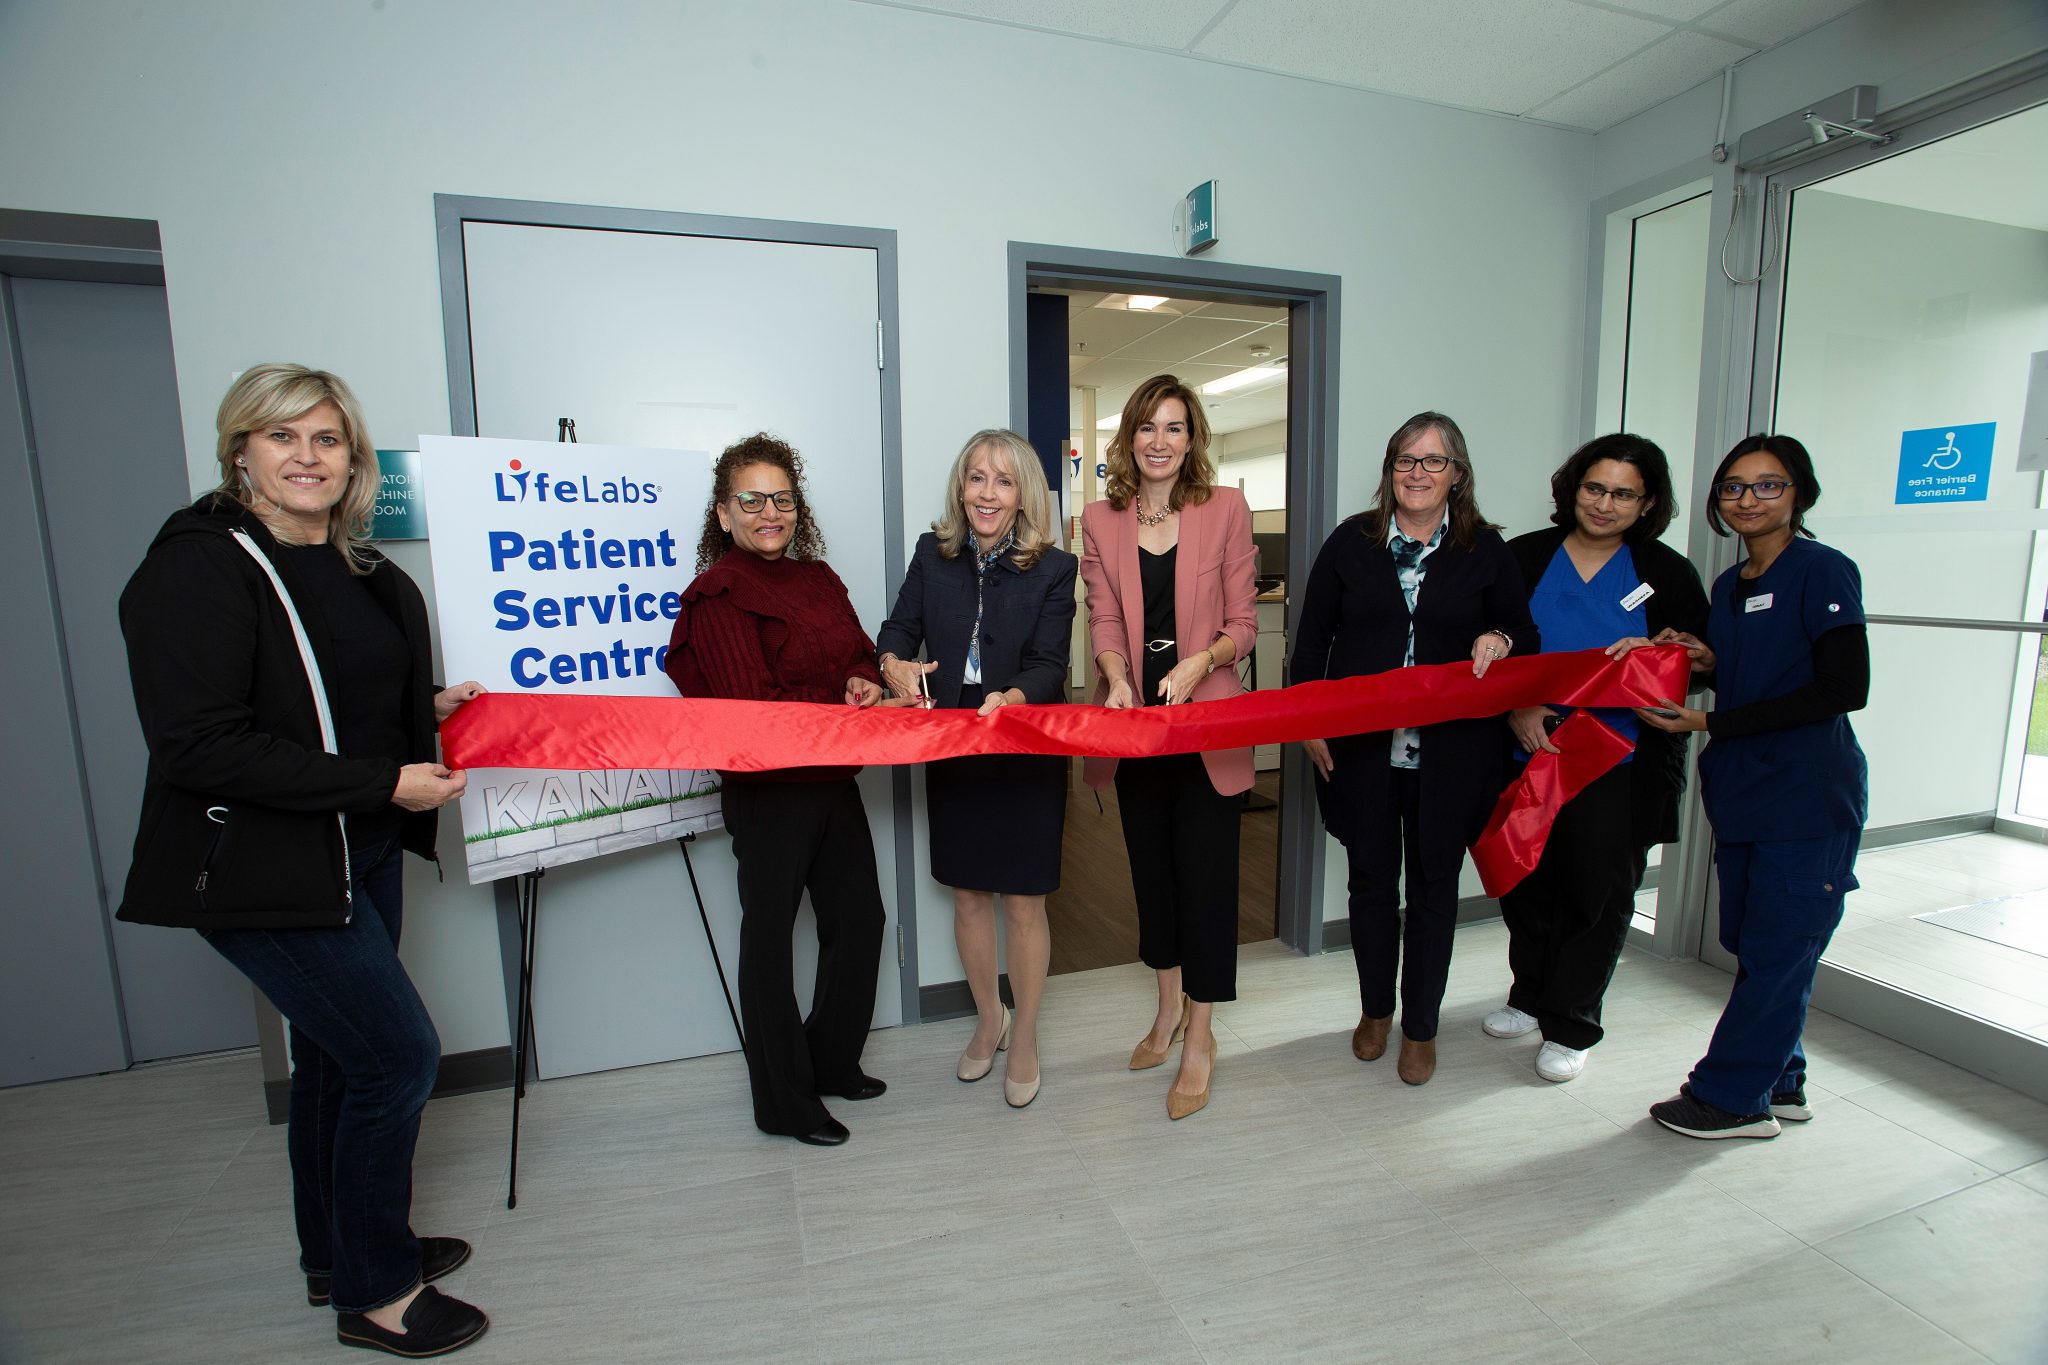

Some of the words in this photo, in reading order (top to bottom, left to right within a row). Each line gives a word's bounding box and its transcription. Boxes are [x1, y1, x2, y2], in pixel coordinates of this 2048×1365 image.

[374, 505, 407, 516] OOM
[488, 528, 677, 572] Patient
[493, 583, 682, 631] Service
